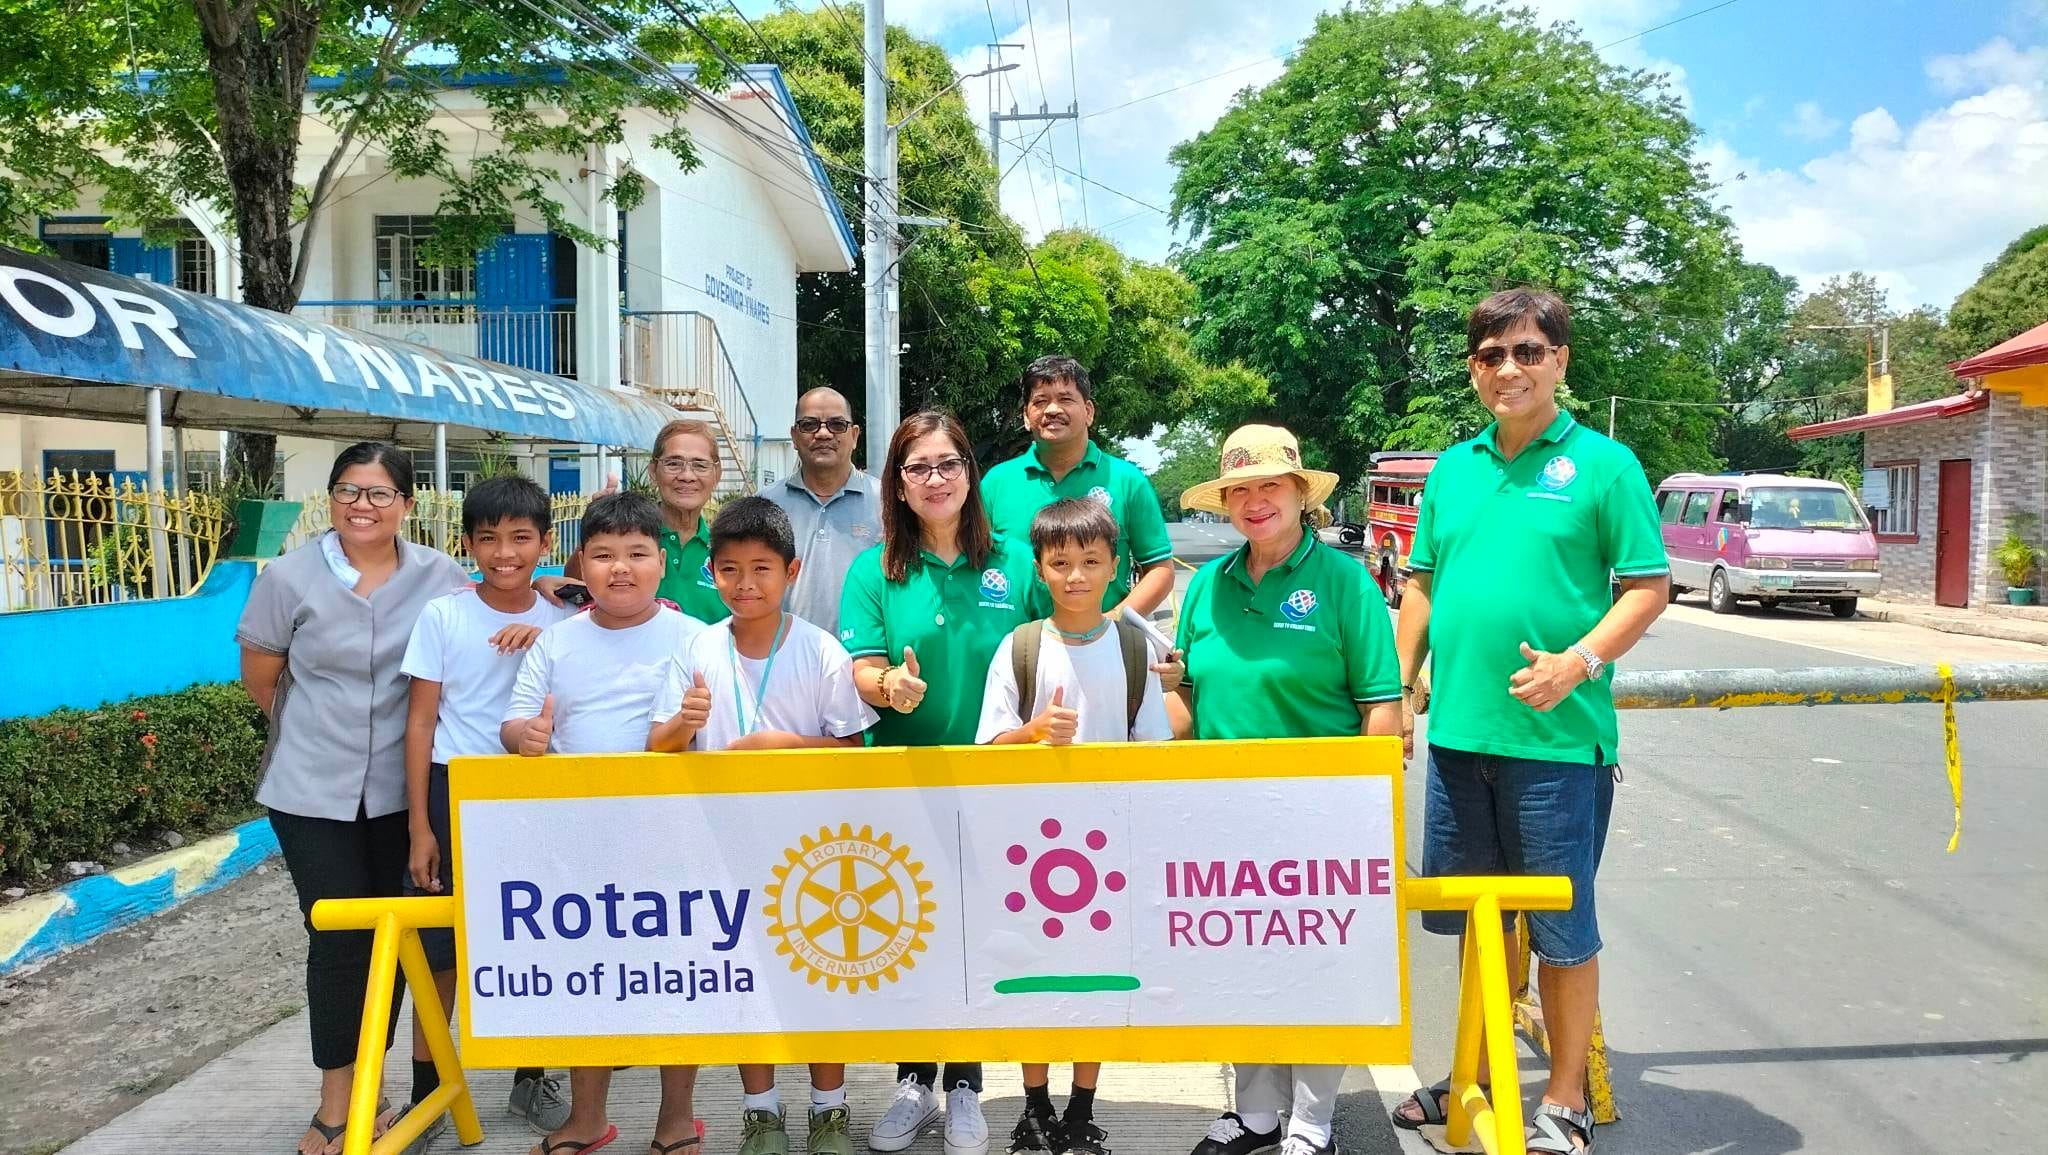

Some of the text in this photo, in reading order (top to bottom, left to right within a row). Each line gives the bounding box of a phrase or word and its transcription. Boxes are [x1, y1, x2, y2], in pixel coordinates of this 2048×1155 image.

[705, 273, 770, 325] GOVERNOR YNARES
[264, 322, 577, 420] YNARES
[811, 841, 884, 863] ROTARY
[1165, 858, 1391, 898] IMAGINE
[500, 880, 751, 951] Rotary
[1168, 908, 1357, 947] ROTARY
[793, 934, 912, 976] INTERNATIONAL
[474, 960, 755, 1002] Club of Jalajala
